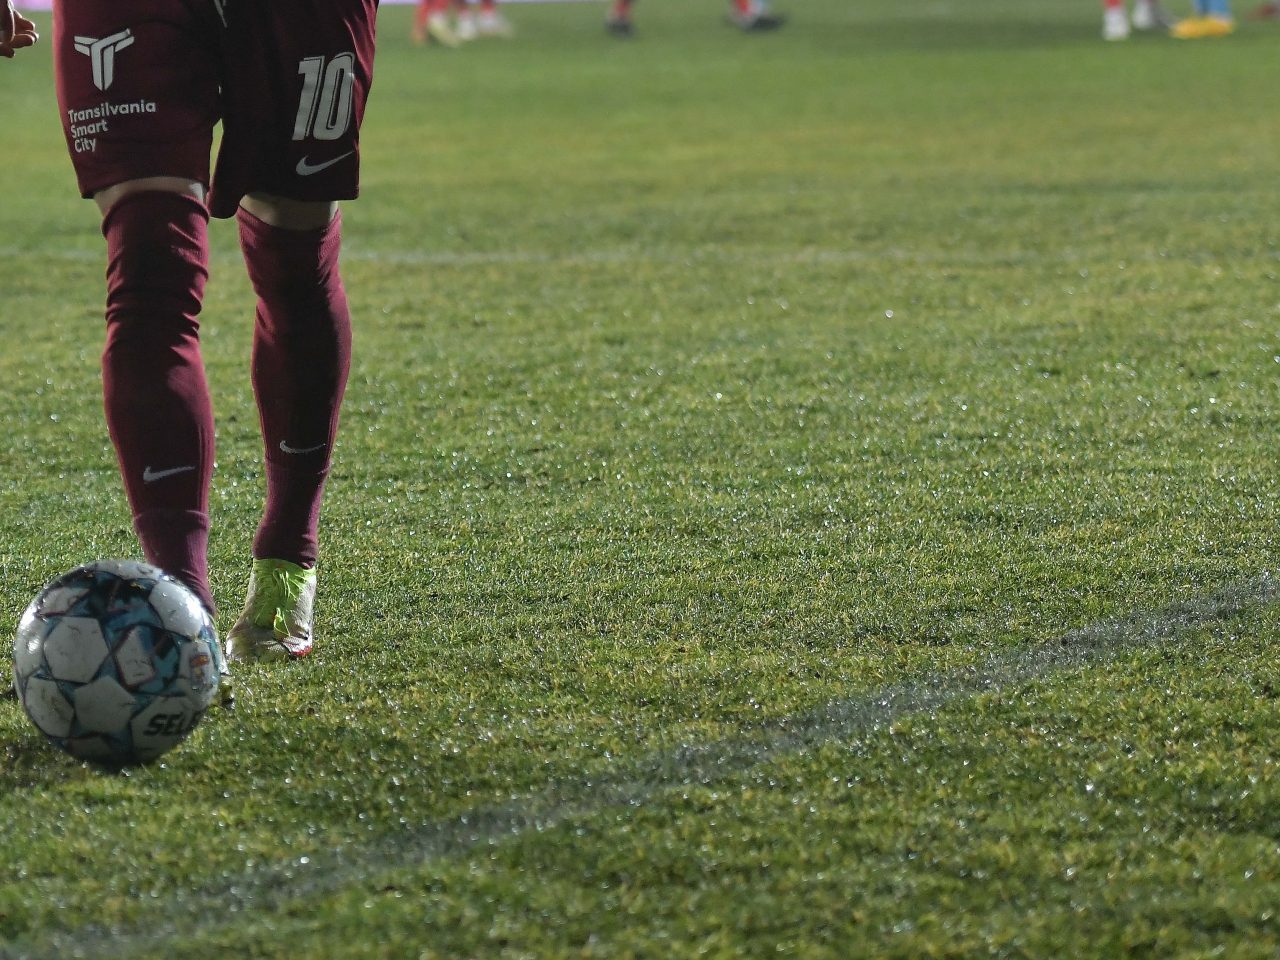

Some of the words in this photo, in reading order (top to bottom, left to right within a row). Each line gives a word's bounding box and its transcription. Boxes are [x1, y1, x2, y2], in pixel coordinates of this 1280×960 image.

[291, 51, 356, 141] 10
[68, 99, 157, 124] Transilvania
[70, 119, 109, 139] Smart
[74, 137, 97, 153] City
